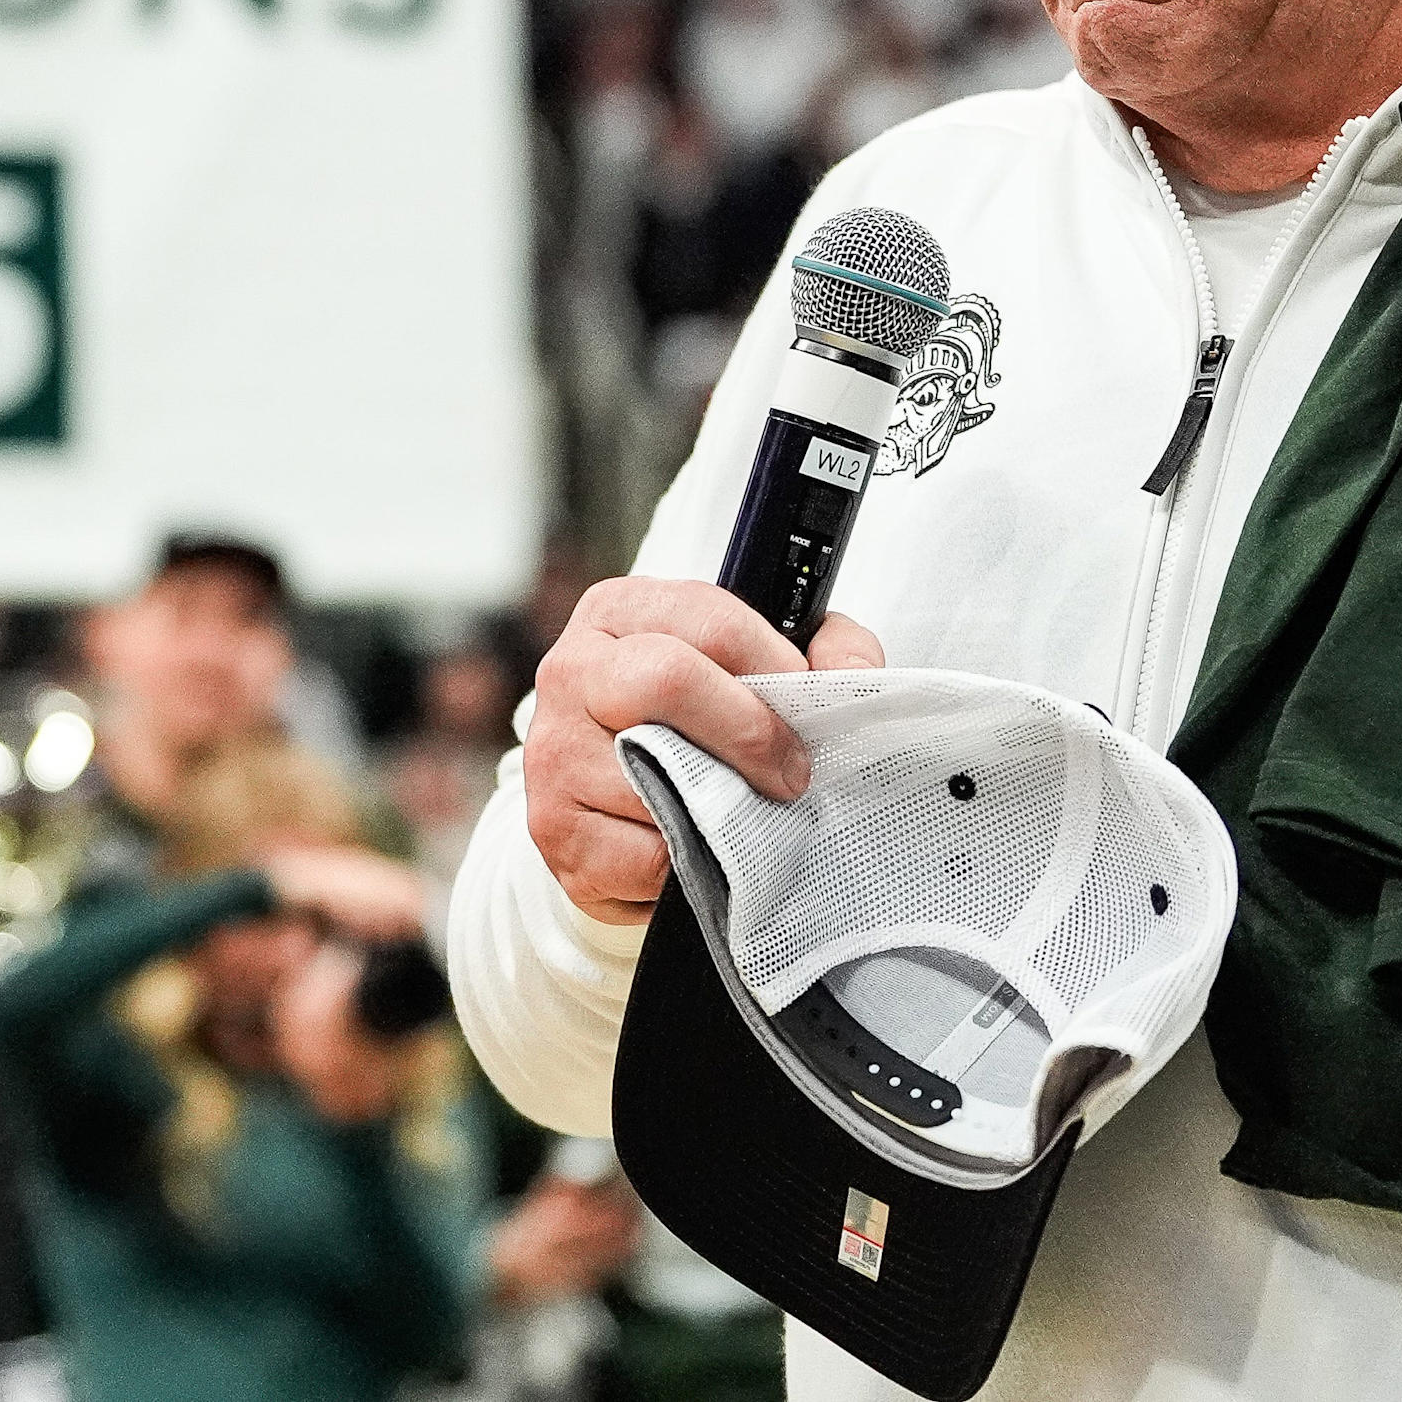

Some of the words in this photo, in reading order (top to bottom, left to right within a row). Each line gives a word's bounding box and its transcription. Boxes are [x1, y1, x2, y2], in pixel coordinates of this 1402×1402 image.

[818, 449, 861, 481] WL2
[789, 534, 811, 547] MODE
[821, 545, 833, 555] SET
[796, 576, 807, 586] ON
[782, 619, 796, 629] OFF
